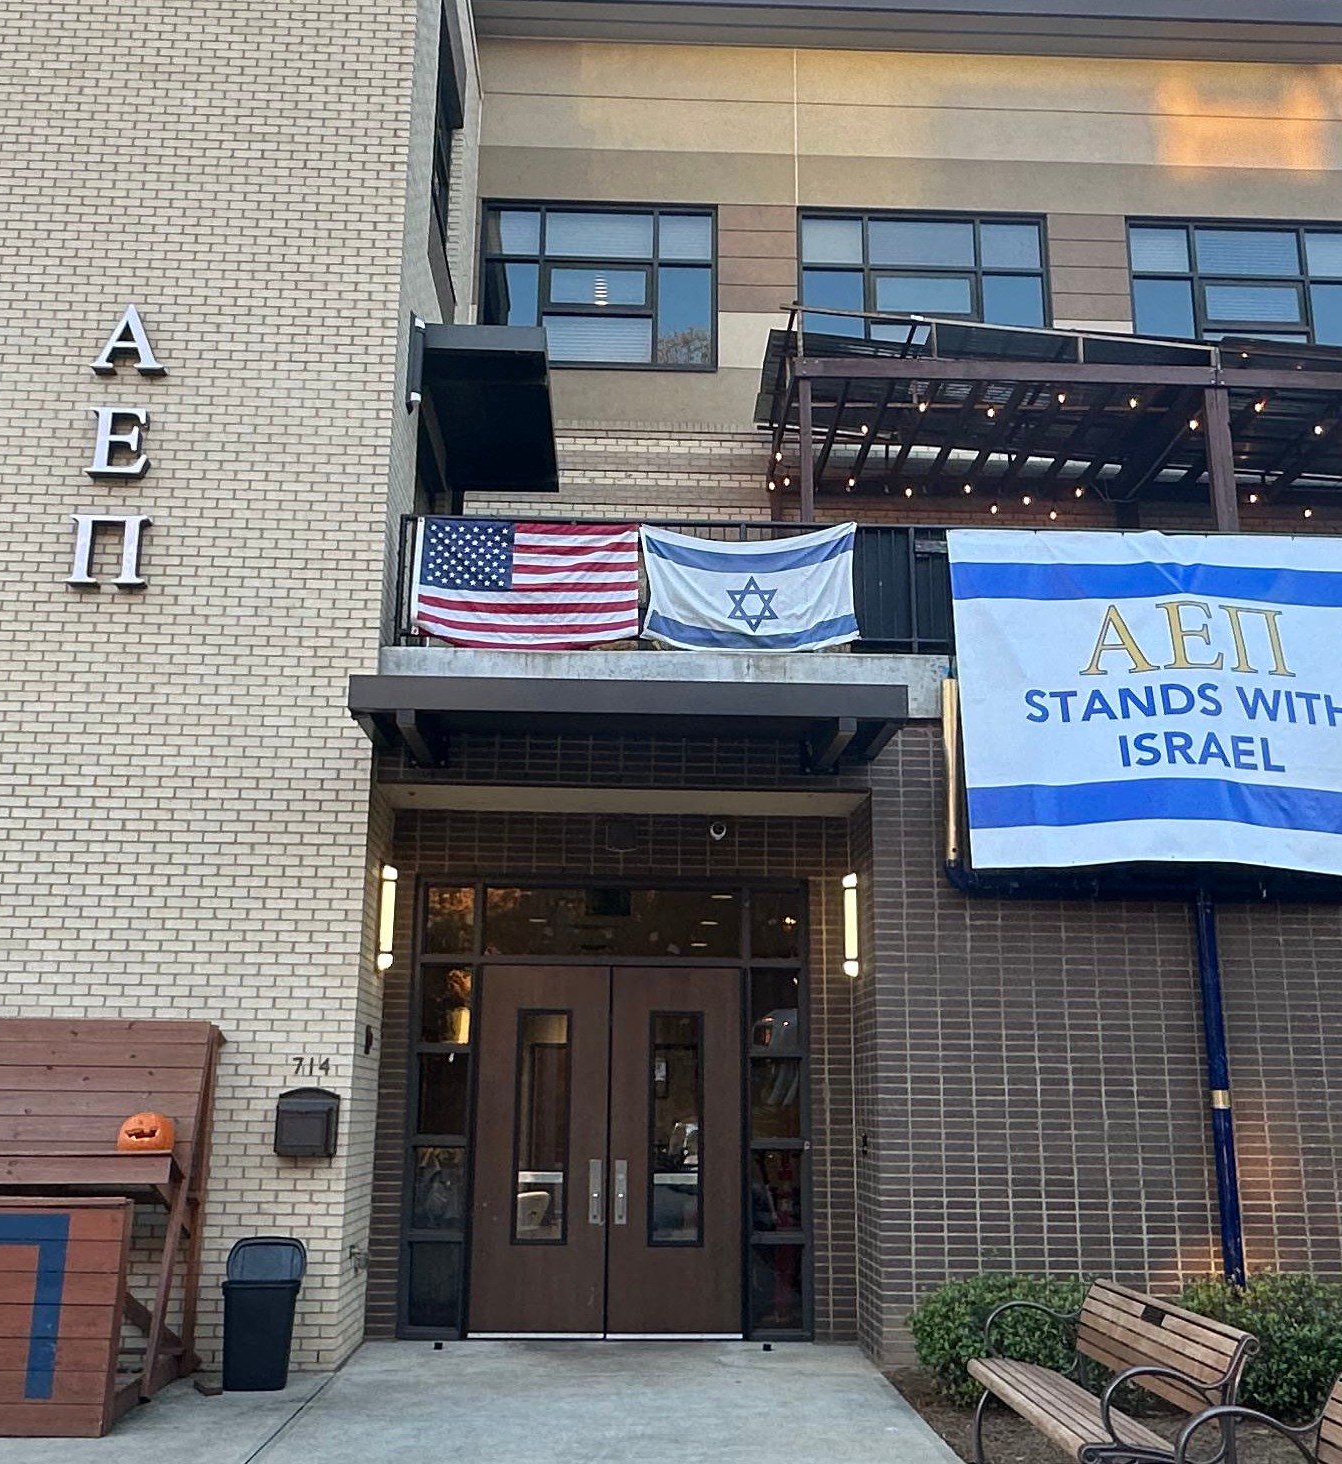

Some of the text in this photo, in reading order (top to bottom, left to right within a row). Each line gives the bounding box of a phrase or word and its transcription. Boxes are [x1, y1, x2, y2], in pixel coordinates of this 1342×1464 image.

[1025, 683, 1221, 723] STANDS
[1118, 731, 1285, 773] ISRAEL
[293, 1057, 330, 1076] 714
